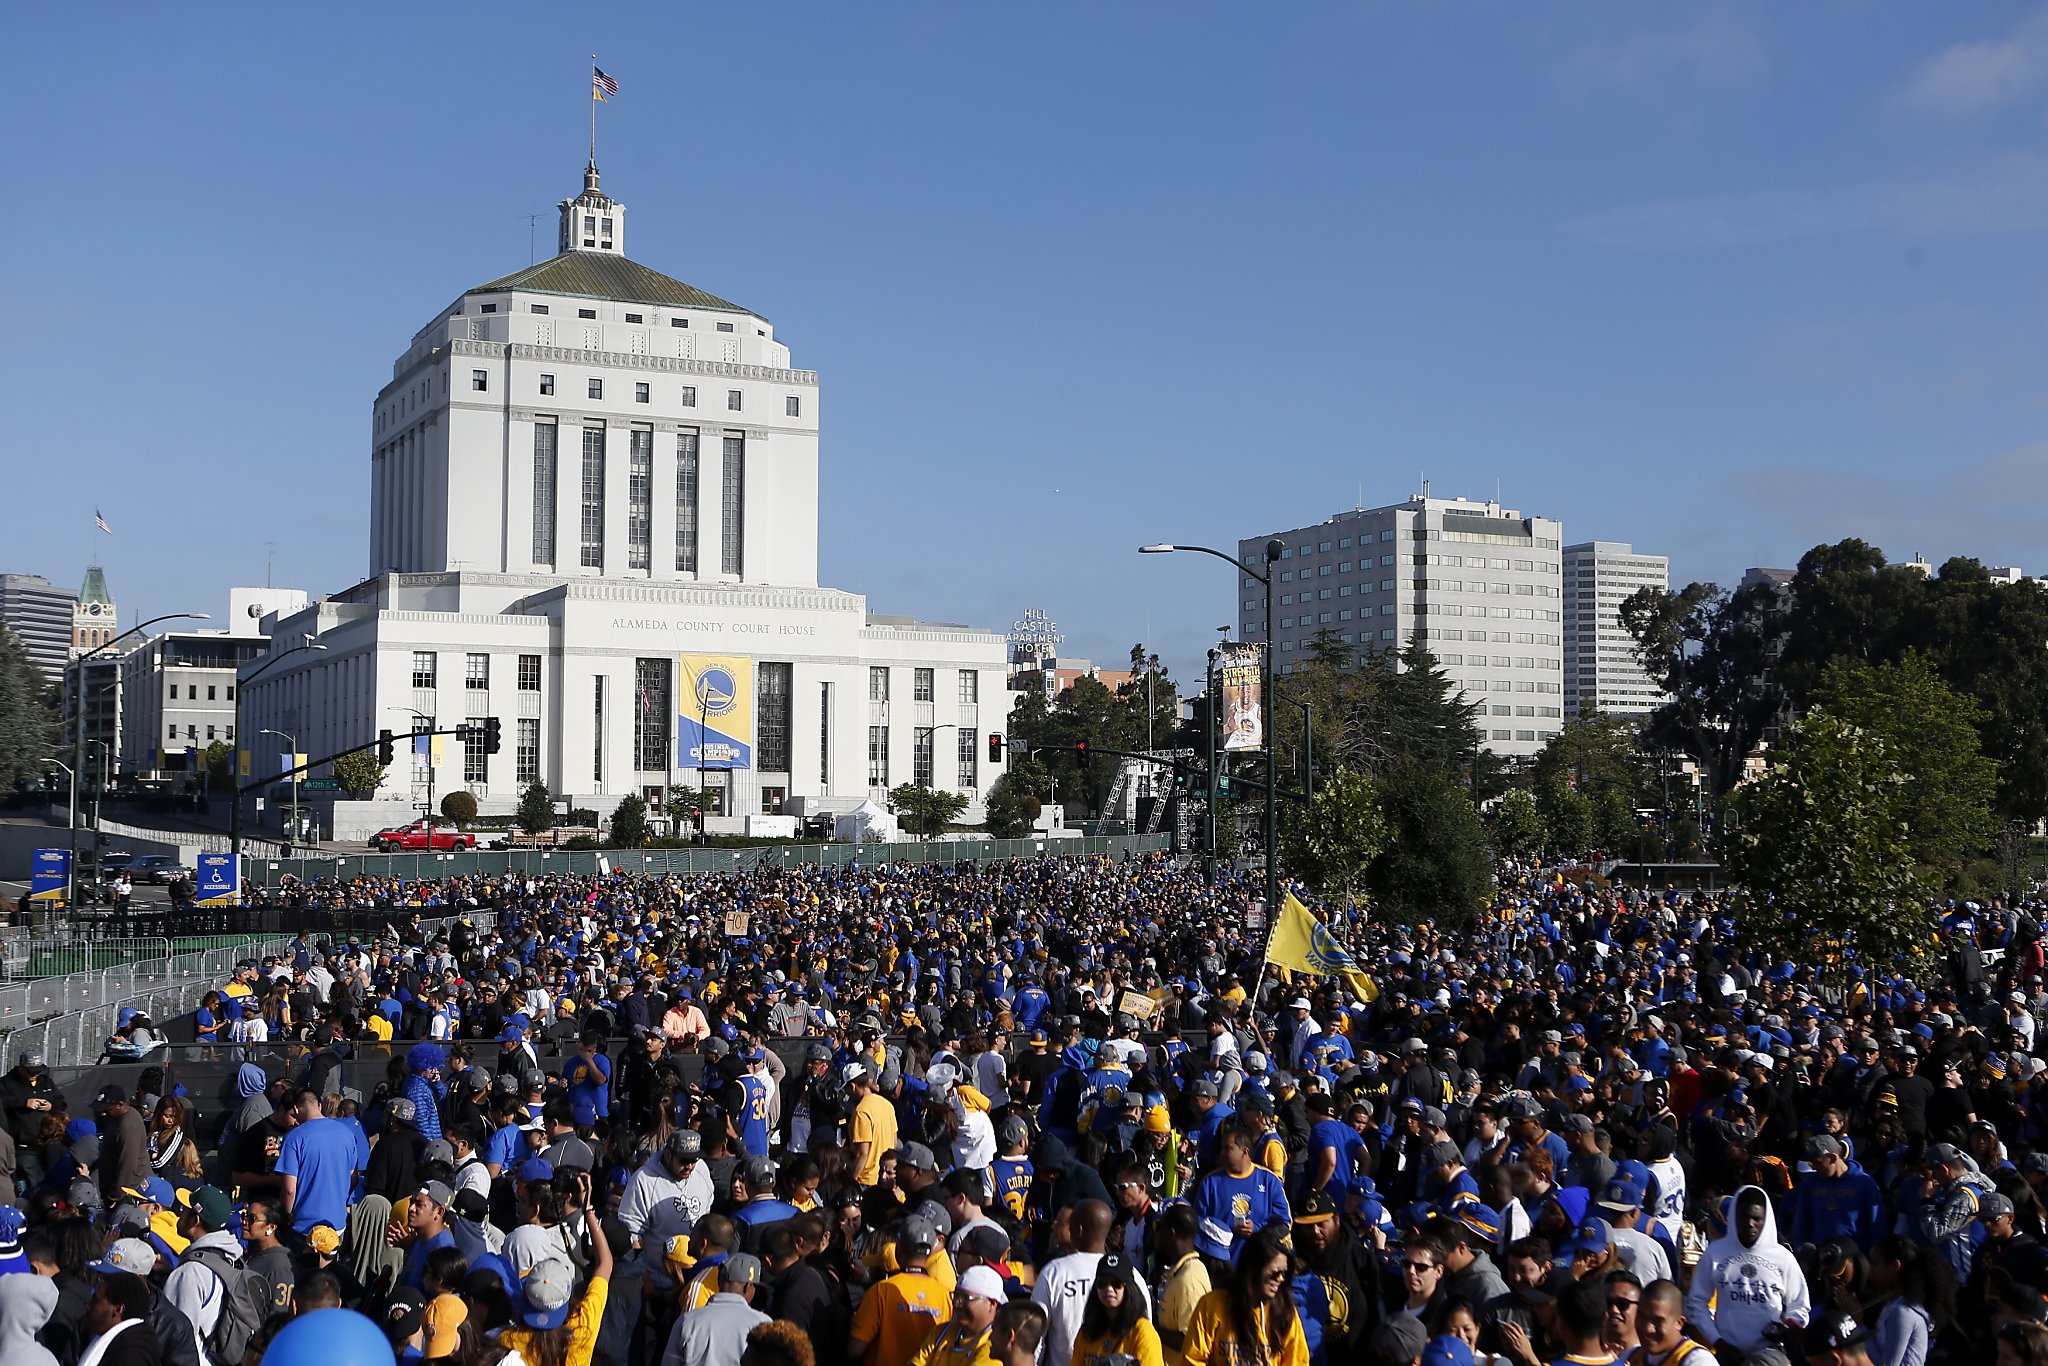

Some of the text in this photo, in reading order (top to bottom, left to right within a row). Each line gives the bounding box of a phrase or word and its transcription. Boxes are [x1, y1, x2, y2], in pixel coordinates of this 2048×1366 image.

[1024, 609, 1048, 619] HILL
[612, 618, 815, 636] ALAMEDA COUNTY COURT HOUSE
[1014, 621, 1057, 632] CASTLE
[1005, 633, 1066, 643] APARTMENT
[695, 663, 736, 677] GOLDEN STATE
[1223, 666, 1260, 678] STRENGTH
[695, 702, 737, 717] WARRIORS
[752, 1098, 767, 1120] 30
